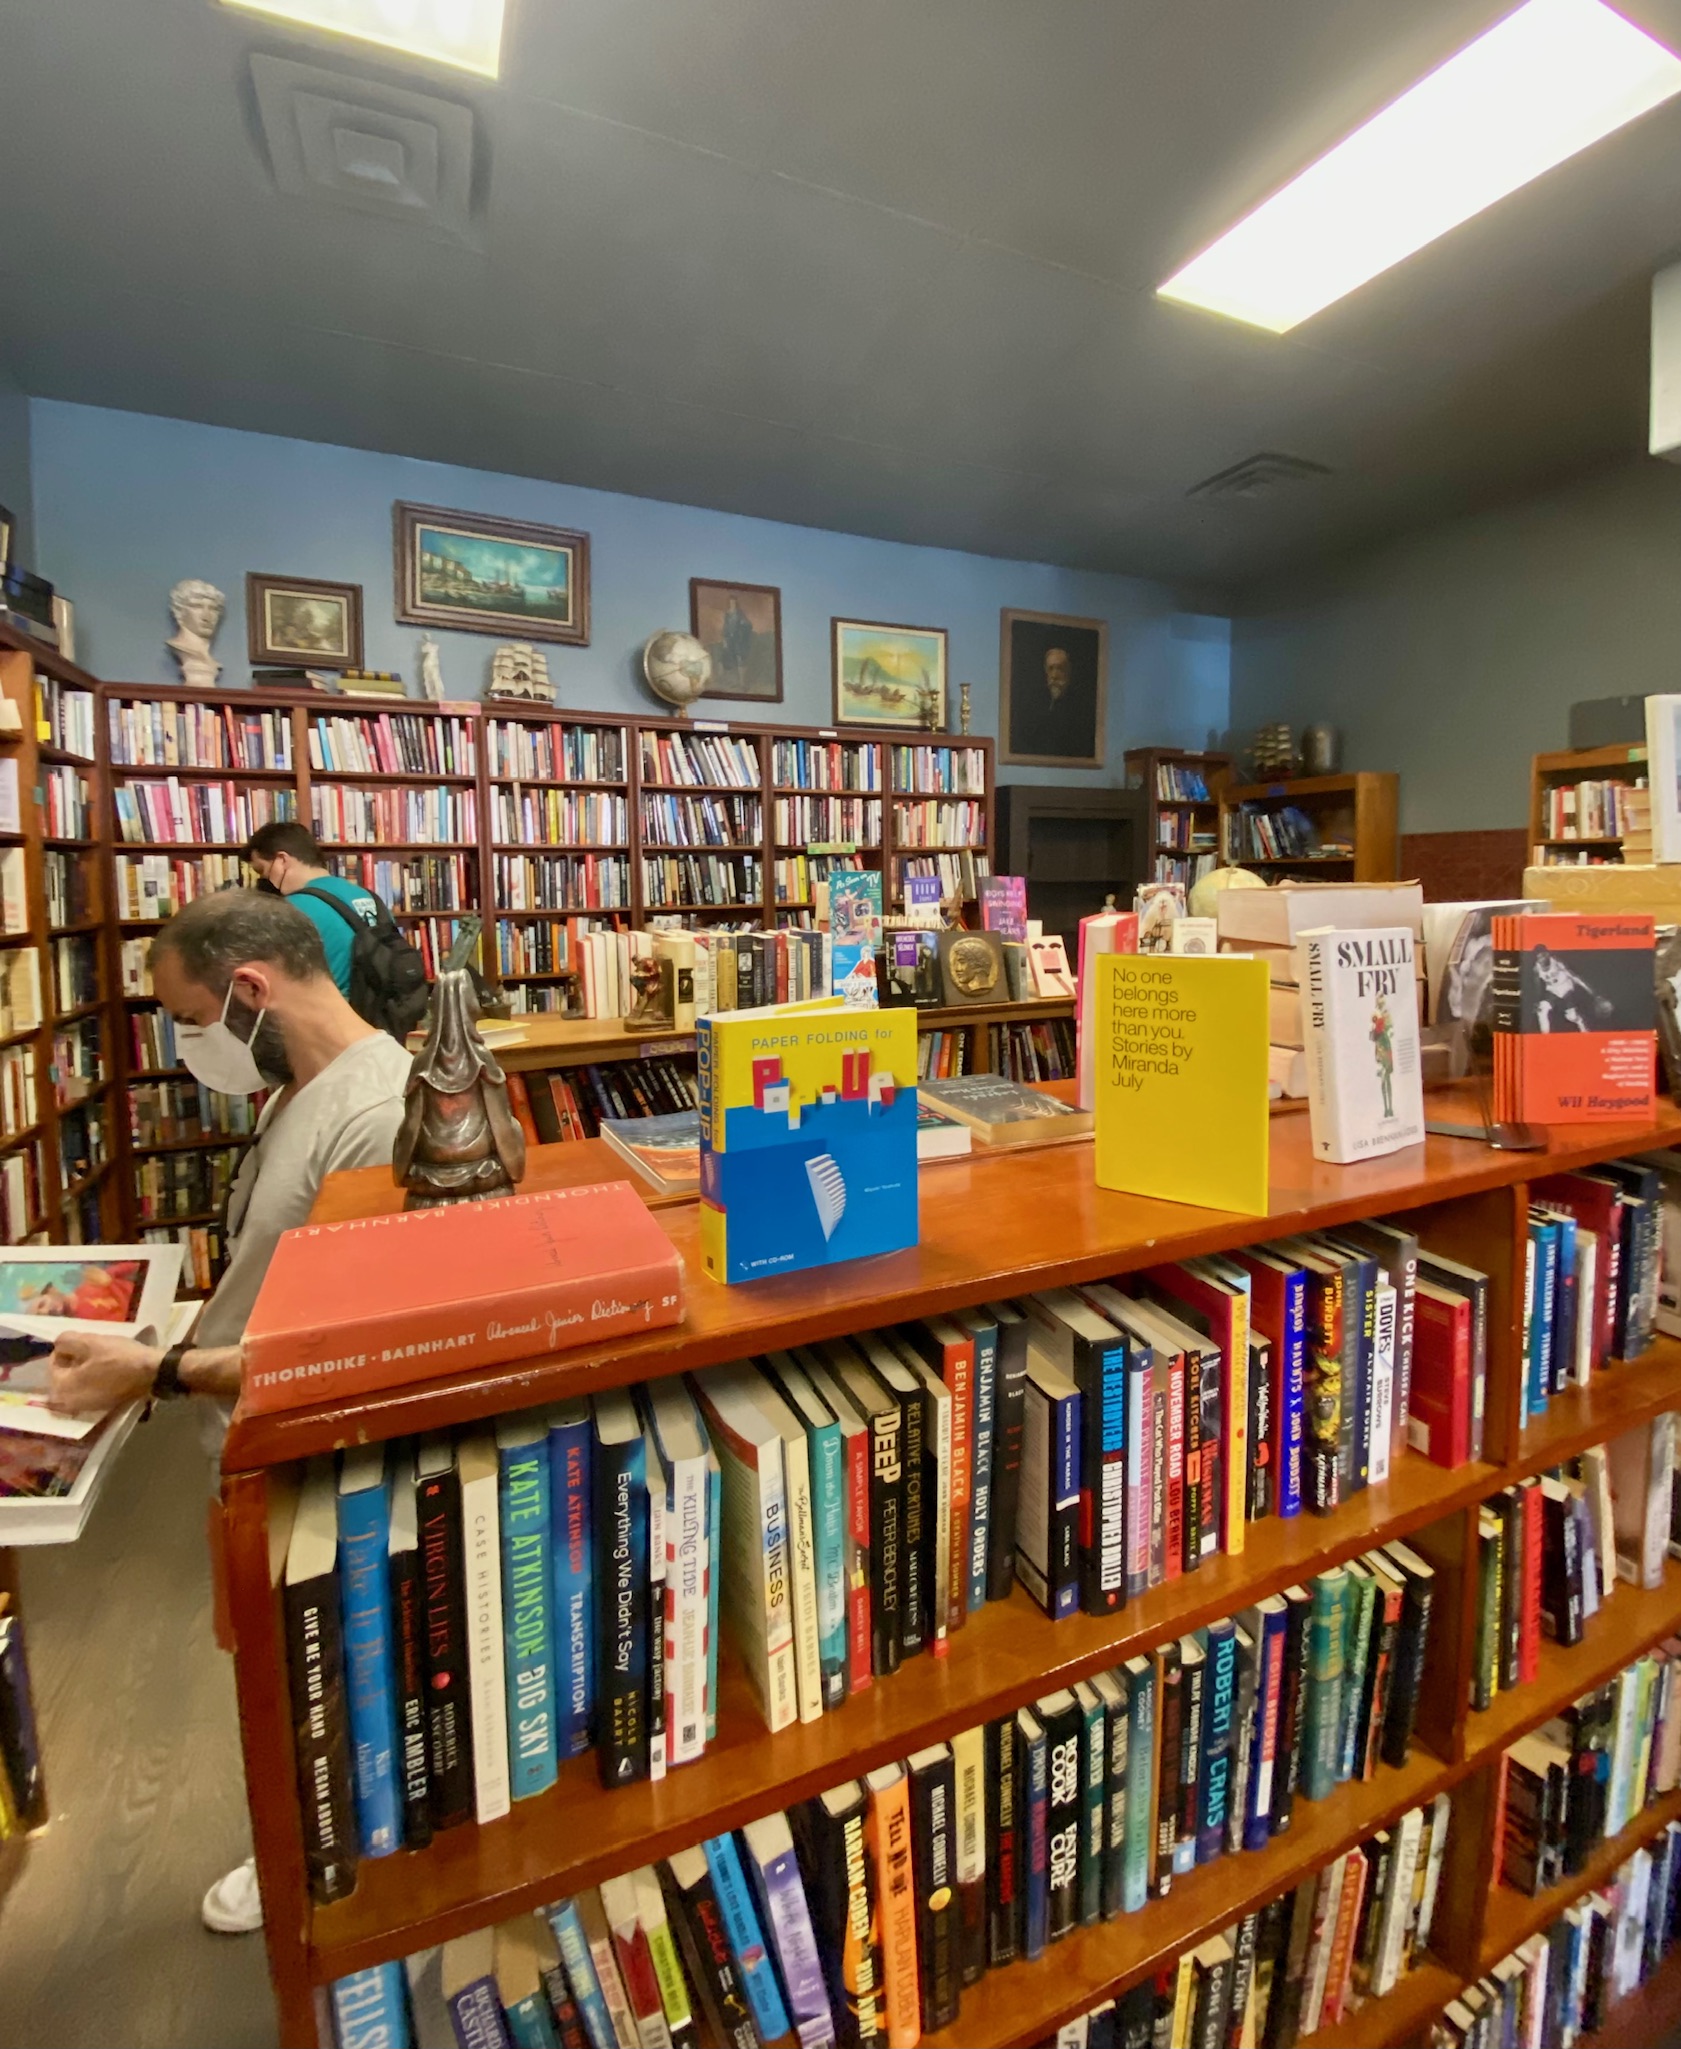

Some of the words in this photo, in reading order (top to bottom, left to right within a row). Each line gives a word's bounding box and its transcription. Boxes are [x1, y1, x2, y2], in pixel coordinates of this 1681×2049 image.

[867, 872, 880, 887] TV
[1338, 938, 1412, 968] SMALL
[1575, 923, 1649, 938] Tigerland
[1112, 967, 1136, 984] No
[1140, 972, 1172, 985] one
[1309, 943, 1323, 994] SMALL
[1357, 968, 1399, 997] FRY
[1112, 985, 1179, 1004] belongs
[1112, 1003, 1148, 1019] here
[1152, 1008, 1197, 1022] more
[1312, 1002, 1325, 1029] FRY
[752, 1035, 799, 1050] PAPER
[807, 1029, 869, 1045] FOLDING
[875, 1028, 893, 1040] for
[1111, 1037, 1168, 1057] Stories
[1172, 1043, 1194, 1062] by
[1112, 1020, 1148, 1037] than
[1150, 1025, 1186, 1041] you.
[698, 1028, 712, 1141] POP-UP
[1111, 1072, 1144, 1092] July
[1112, 1055, 1180, 1076] Miranda
[712, 1063, 720, 1123] FOLDING
[1559, 1096, 1583, 1108] Wil
[1587, 1095, 1649, 1110] Haygood
[474, 1183, 625, 1213] THORNDIKE
[287, 1208, 447, 1240] BARNHART
[750, 1257, 768, 1268] WITH
[768, 1253, 795, 1265] CD-ROM
[1404, 1258, 1417, 1298] ONE
[662, 1294, 678, 1307] SF
[1324, 1287, 1334, 1345] BURDETT
[1363, 1290, 1374, 1338] SISTER
[1378, 1304, 1394, 1354] DOVES
[1401, 1303, 1415, 1345] KICK
[253, 1353, 367, 1389] THORNDIKE
[381, 1333, 477, 1363] BARNHART
[486, 1318, 541, 1341] Advanced
[545, 1309, 585, 1348] Junior
[1103, 1346, 1123, 1371] THE
[1290, 1341, 1303, 1394] HAUNTS
[978, 1347, 994, 1424] BENJAMIN
[1401, 1350, 1411, 1397] CHELSEA
[953, 1360, 968, 1442] BENJAMIN
[1102, 1373, 1123, 1452] DESTROYERS
[1154, 1409, 1163, 1424] The
[1169, 1370, 1183, 1440] NOVEMBER
[1375, 1379, 1383, 1429] BURROWS
[1399, 1402, 1408, 1427] CAIN
[873, 1411, 901, 1485] DEEP
[1154, 1425, 1163, 1439] Cat
[1290, 1411, 1301, 1440] JOHN
[1362, 1409, 1371, 1449] BURKE
[565, 1447, 580, 1487] KATE
[976, 1431, 991, 1476] BLACK
[1064, 1445, 1072, 1460] THE
[1153, 1457, 1164, 1485] Played
[1154, 1440, 1163, 1457] Who
[1169, 1444, 1182, 1478] ROAD
[508, 1459, 539, 1523] KATE
[686, 1475, 694, 1492] THE
[855, 1463, 863, 1498] SIMPLE
[952, 1449, 965, 1498] BLACK
[1064, 1462, 1072, 1490] MARAIS
[1289, 1446, 1301, 1497] BURDETT
[613, 1471, 633, 1558] Everything
[855, 1499, 863, 1533] FAVOR
[974, 1486, 989, 1521] HOLY
[1101, 1460, 1122, 1545] CHRISTOPHER
[1169, 1482, 1181, 1508] LOU
[474, 1515, 487, 1559] CASE
[567, 1494, 586, 1575] ATKINSON
[681, 1493, 699, 1558] KILLING
[884, 1497, 898, 1539] PETER
[1168, 1511, 1181, 1557] BERNEY
[423, 1513, 448, 1600] VIRGIN
[617, 1558, 633, 1588] We
[766, 1502, 785, 1608] BUSINESS
[972, 1526, 987, 1577] ORDERS
[511, 1535, 545, 1659] ATKINSON
[683, 1557, 698, 1599] TIDE
[884, 1539, 898, 1613] BENCHLEY
[302, 1606, 319, 1640] GIVE
[428, 1606, 450, 1659] LIES
[477, 1571, 491, 1665] HISTORIES
[617, 1590, 633, 1638] Didn't
[304, 1640, 321, 1662] ME
[570, 1591, 586, 1715] TRANSCRIPTION
[615, 1638, 633, 1672] Say
[306, 1664, 324, 1701] YOUR
[516, 1663, 546, 1709] BIG
[1213, 1637, 1235, 1733] ROBERT
[309, 1703, 327, 1740] HAND
[405, 1699, 419, 1728] ERIC
[444, 1702, 458, 1770] RODERICK
[518, 1711, 548, 1760] SKY
[613, 1697, 623, 1747] BAART
[627, 1690, 638, 1746] NICOLE
[312, 1755, 332, 1800] MEGAN
[405, 1732, 427, 1801] AMBLER
[1051, 1744, 1067, 1808] COOK
[1063, 1735, 1078, 1804] ROBIN
[931, 1784, 947, 1833] MICHAEL
[1206, 1756, 1229, 1828] CRAIS
[315, 1802, 336, 1849] ABBOTT
[889, 1805, 905, 1846] TELL
[844, 1815, 865, 1886] HARLAN
[931, 1834, 948, 1886] CONNELLY
[1050, 1832, 1066, 1891] CURE
[1063, 1821, 1078, 1889] FATAL
[848, 1886, 870, 1941] COBEN
[1239, 1913, 1256, 1955] INCE
[894, 1907, 914, 1972] HARLAN
[855, 1957, 874, 1994] RUN
[1232, 1958, 1252, 2011] FLYNN
[857, 1994, 878, 2039] AWAY
[895, 1972, 916, 2029] COBEN
